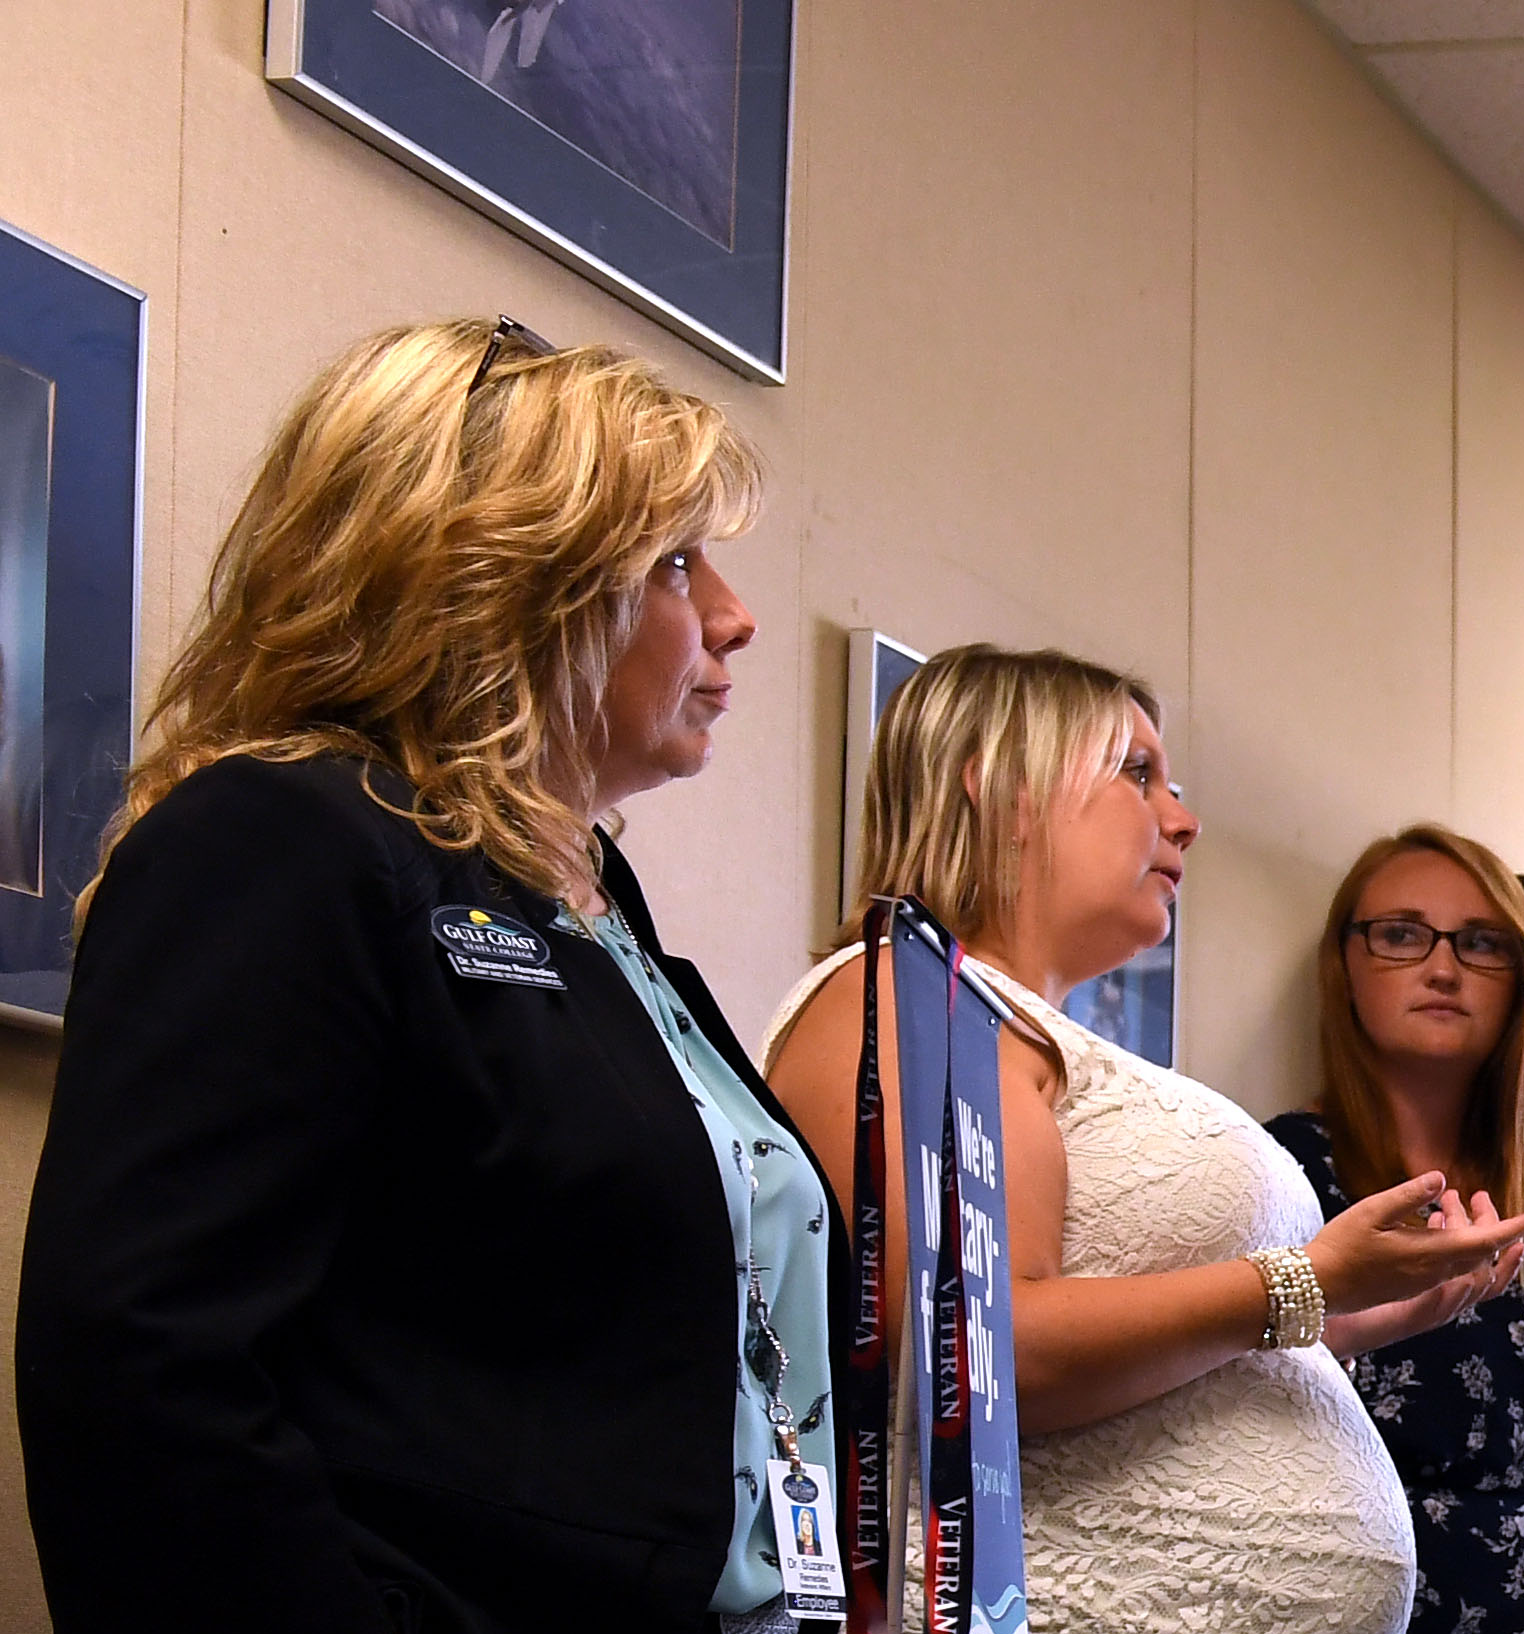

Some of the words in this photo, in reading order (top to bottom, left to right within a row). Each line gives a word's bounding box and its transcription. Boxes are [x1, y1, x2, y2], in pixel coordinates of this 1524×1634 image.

[443, 924, 486, 943] GULF
[487, 931, 538, 951] COAST
[957, 1097, 996, 1190] We're
[855, 1204, 880, 1347] VETERAN
[940, 1276, 961, 1419] VETERAN
[852, 1430, 880, 1571] VETERAN
[933, 1496, 968, 1634] VETERAN
[796, 1594, 840, 1611] Employee
